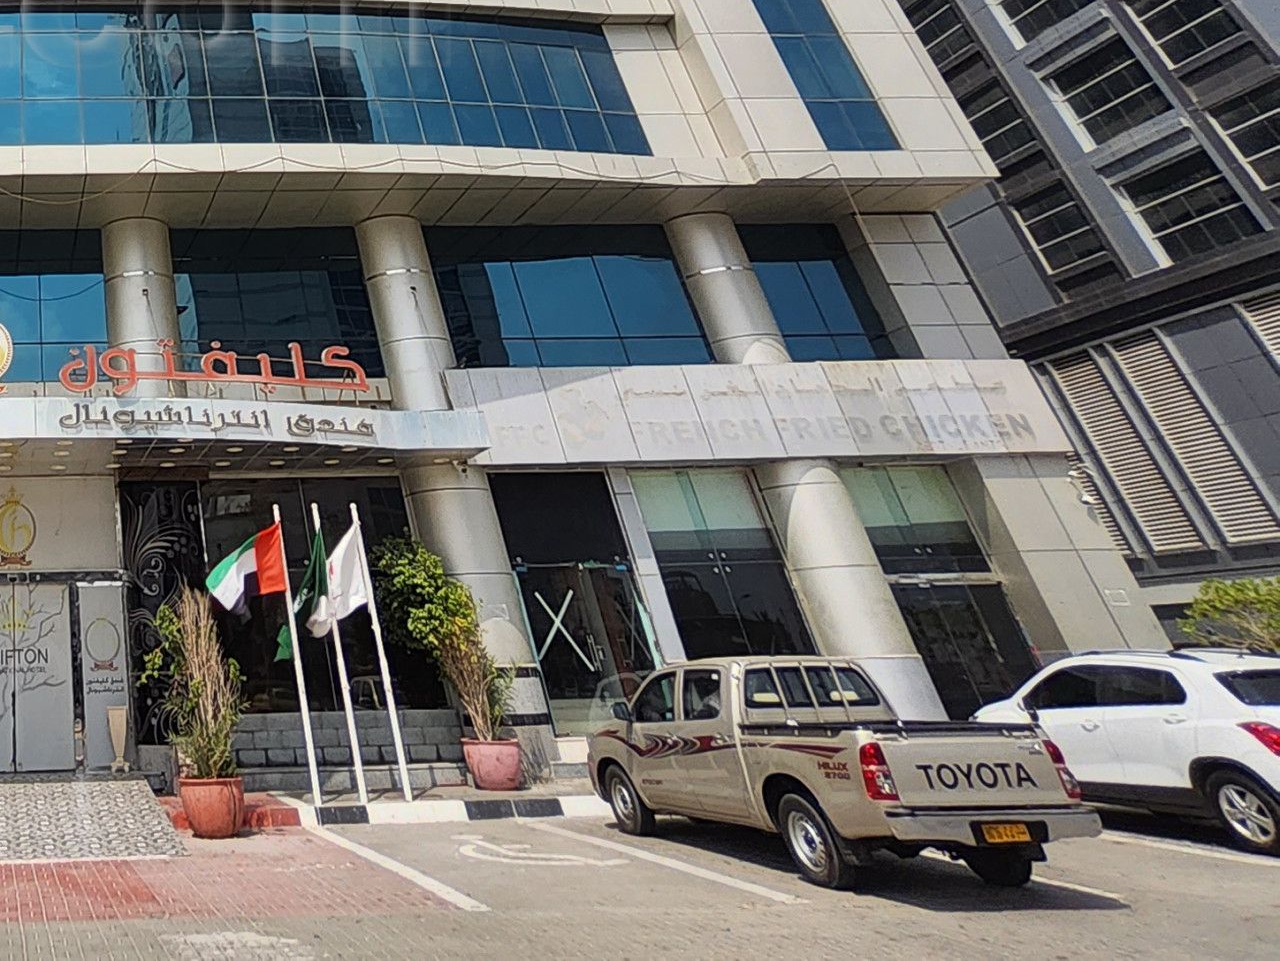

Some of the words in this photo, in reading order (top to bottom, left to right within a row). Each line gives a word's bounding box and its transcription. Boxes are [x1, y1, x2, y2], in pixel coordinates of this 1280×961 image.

[58, 338, 371, 395] كليفتون
[286, 413, 376, 437] فندق
[631, 418, 767, 444] FRENCH
[776, 415, 871, 440] FRIED
[879, 413, 1037, 440] CHICKEN
[818, 761, 848, 772] HILUX
[915, 762, 1039, 789] TOYOTA
